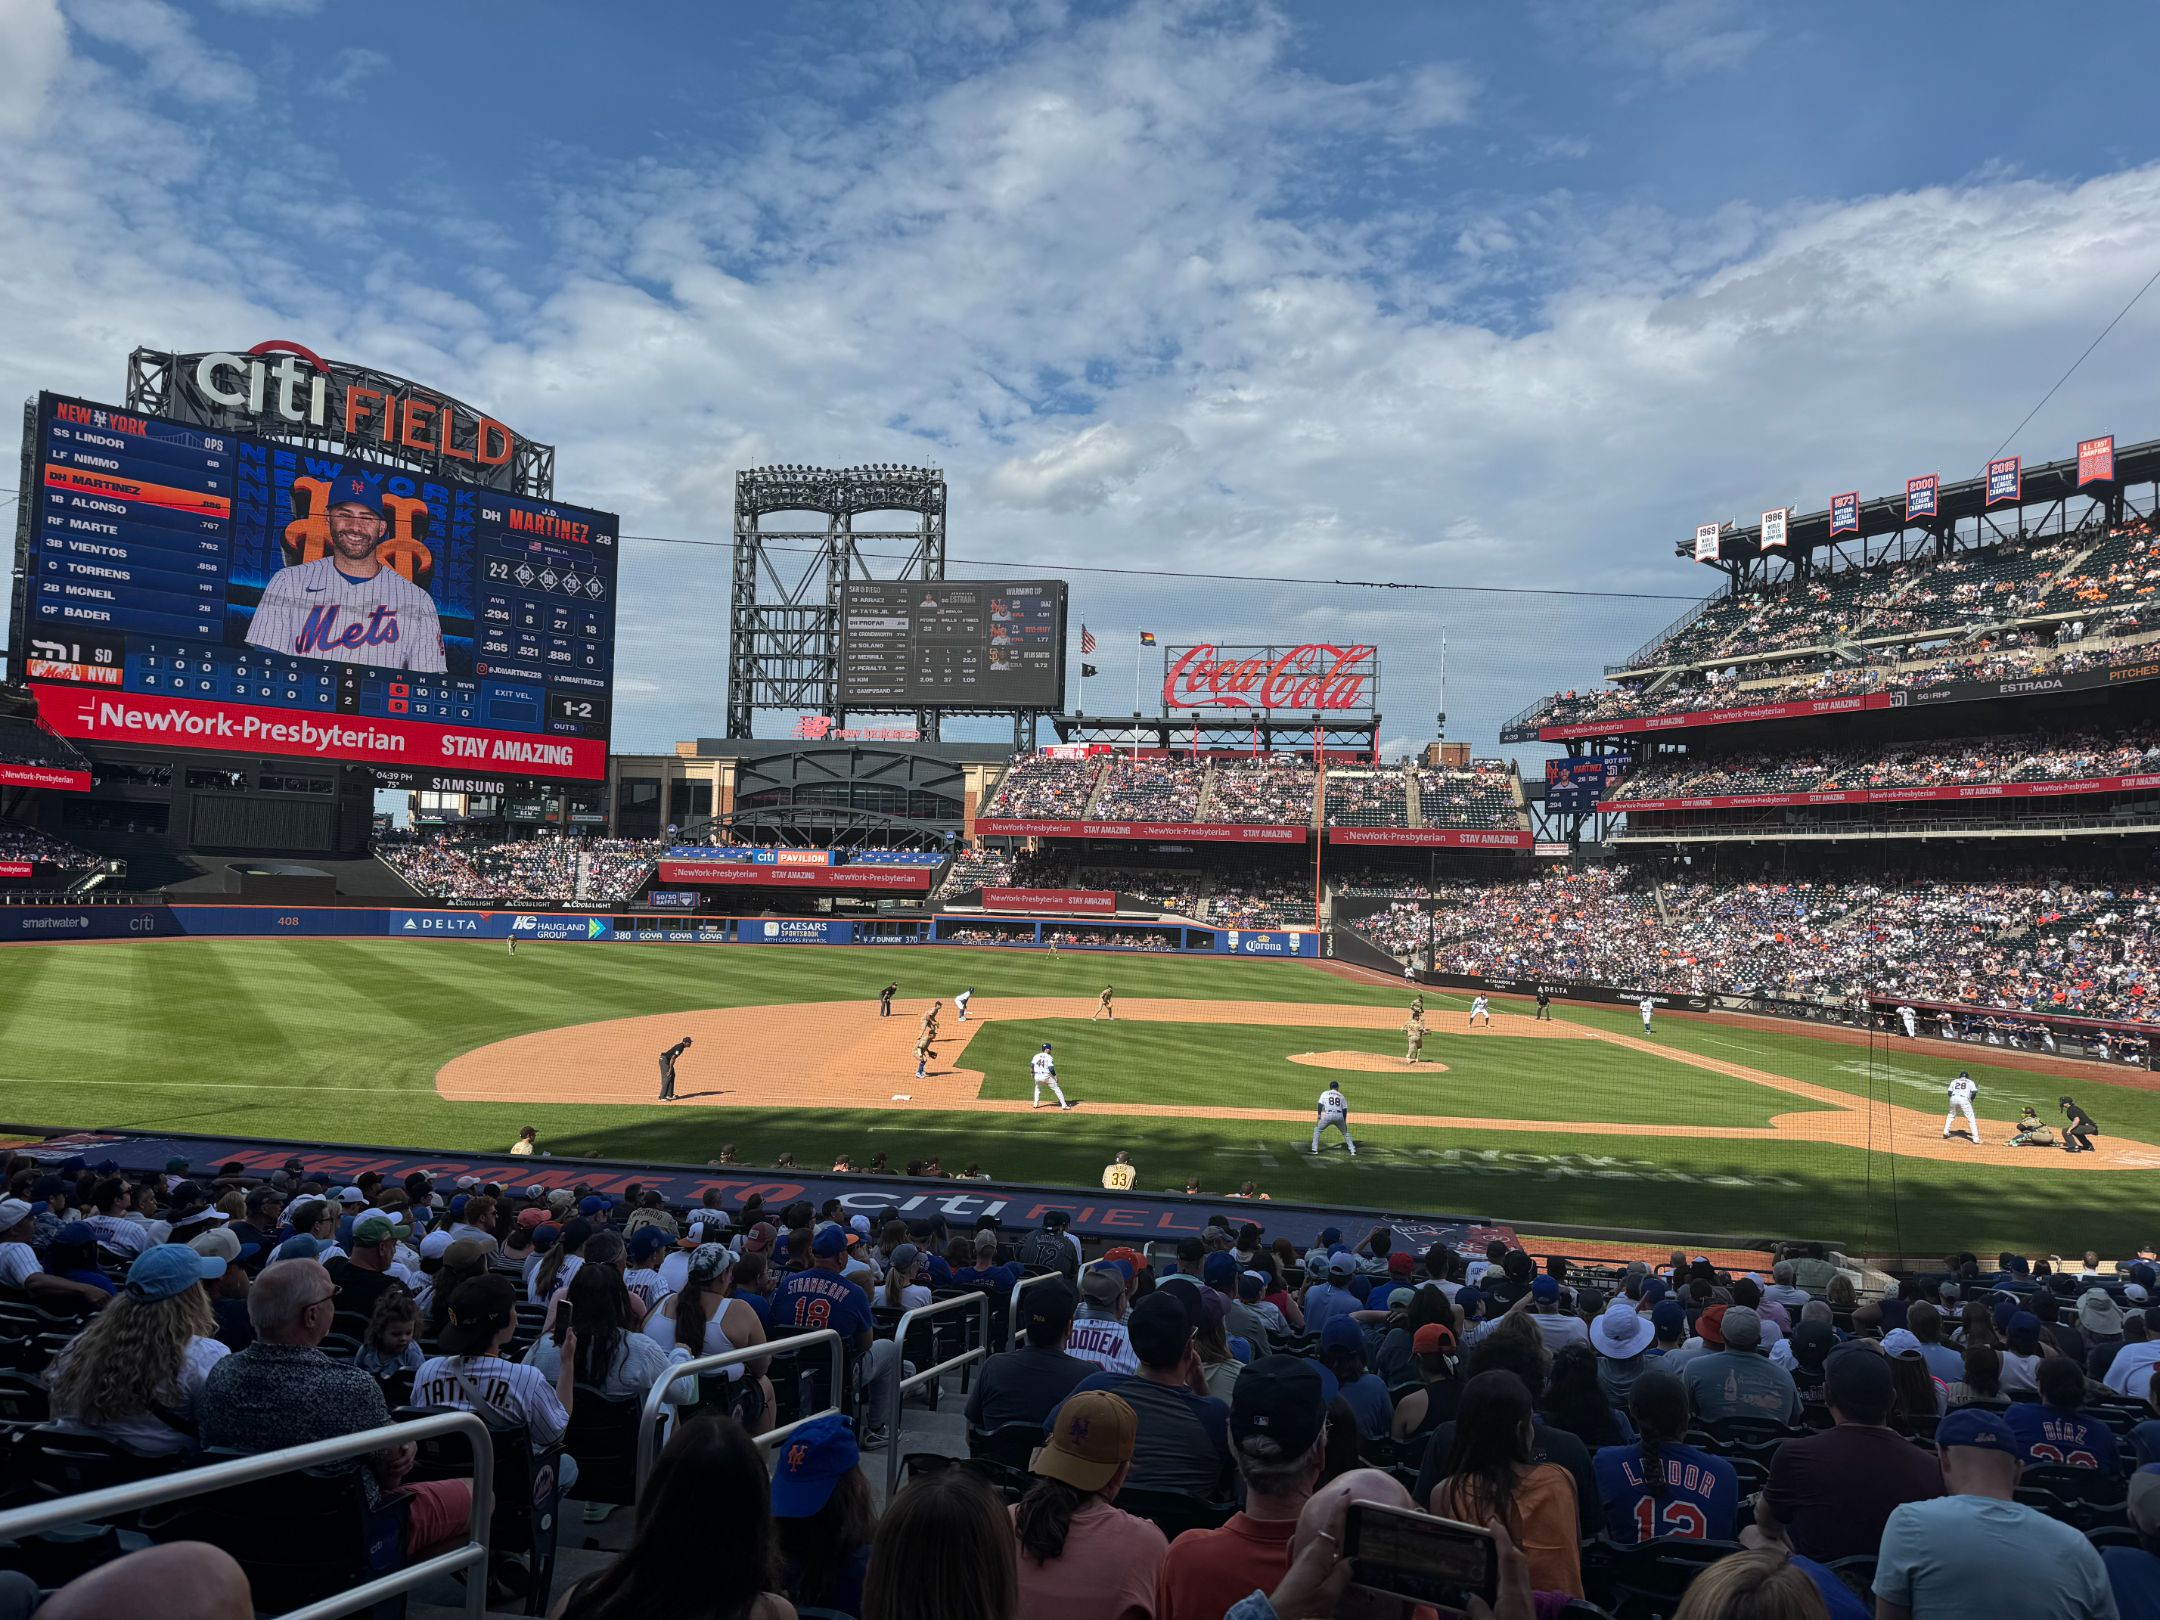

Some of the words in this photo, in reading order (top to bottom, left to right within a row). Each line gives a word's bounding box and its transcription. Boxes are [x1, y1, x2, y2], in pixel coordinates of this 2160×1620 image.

[56, 401, 92, 425] NEW
[109, 414, 148, 437] YORK
[345, 384, 513, 466] FIELD
[53, 427, 70, 438] SS
[75, 430, 125, 450] LINDOR
[206, 459, 220, 468] BB
[204, 436, 224, 452] OPS
[52, 449, 68, 460] LF
[73, 452, 120, 470] NIMMO
[207, 480, 218, 489] 1B
[1991, 460, 2016, 474] 2015
[49, 471, 67, 482] DH
[72, 474, 140, 496] MARTINEZ
[1909, 477, 1934, 492] 2000
[50, 494, 64, 504] 1B
[71, 497, 127, 515] ALONSO
[199, 521, 220, 531] .767
[482, 508, 501, 522] DH
[541, 508, 560, 518] J.D.
[1765, 511, 1783, 523] 1986
[47, 516, 65, 526] RF
[69, 518, 118, 535] MARTE
[198, 541, 219, 551] .762
[509, 508, 589, 545] MARTINEZ
[1699, 526, 1716, 537] 1969
[595, 533, 612, 546] 28
[46, 538, 63, 549] 3B
[68, 540, 128, 559] VIENTOS
[197, 563, 218, 572] .858
[48, 561, 58, 570] C
[67, 562, 131, 580] TORRENS
[199, 584, 213, 592] HR
[489, 562, 508, 579] 2-2
[43, 582, 60, 593] 2B
[65, 585, 116, 601] MCNEIL
[198, 604, 211, 612] 2B
[490, 597, 505, 605] AVG
[41, 605, 59, 615] CF
[64, 607, 111, 622] BADER
[198, 625, 209, 633] 1B
[484, 609, 510, 621] .294
[525, 615, 533, 624] 8
[295, 605, 400, 655] Mets
[553, 620, 568, 629] 27
[585, 624, 597, 634] 18
[482, 641, 508, 653] .365
[517, 646, 539, 657] .521
[547, 650, 571, 662] .886
[94, 648, 113, 664] SD
[416, 688, 428, 697] 10
[488, 666, 542, 680] @JDMARTINEZ28
[1164, 643, 1377, 709] Coca-Cola
[2109, 664, 2159, 681] PITCHES
[87, 664, 118, 683] NYM
[415, 705, 427, 713] 13
[457, 682, 475, 690] MVR
[554, 675, 605, 688] @JDMARTINEZ28
[1999, 678, 2063, 693] ESTRADA
[495, 689, 513, 698] EXIT
[515, 691, 533, 700] VEL.
[563, 700, 593, 718] 1-2
[1713, 707, 1786, 721] NewYork-Presbyterian
[1813, 702, 1829, 711] STAY
[1829, 699, 1860, 709] AMAZING
[100, 701, 405, 752] NewYork-Presbyterian
[441, 734, 491, 760] STAY
[491, 740, 573, 766] AMAZING
[832, 728, 862, 739] new
[863, 727, 920, 740] balance
[5, 770, 74, 784] NewYork-Presbyterian
[376, 771, 399, 781] 04:39
[400, 773, 413, 781] PM
[432, 777, 505, 794] SAMSUNG
[1870, 789, 1936, 799] NewYork-Presbyterian
[1960, 788, 1974, 796] STAY
[1975, 786, 2002, 795] AMAZING
[2033, 782, 2100, 793] NewYork-Presbyterian
[992, 822, 1071, 833] NewYork-Presbyterian
[1083, 826, 1100, 834] STAY
[1101, 826, 1131, 835] AMAZING
[1148, 826, 1230, 838] NewYork-Presbyterian
[1243, 829, 1260, 838] STAY
[1260, 829, 1293, 839] AMAZING
[1349, 831, 1446, 843] NewYork-Presbyterian
[1459, 833, 1479, 844] STAY
[1481, 834, 1519, 845] AMAZING
[757, 850, 775, 862] citi
[780, 853, 825, 864] PAVILION
[677, 868, 758, 879] NewYork-Presbyterian
[771, 871, 787, 879] STAY
[788, 871, 815, 880] AMAZING
[834, 873, 916, 884] NewYork-Presbyterian
[656, 892, 677, 900] 50/50
[990, 893, 1063, 904] NewYork-Presbyterian
[1068, 897, 1083, 905] STAY
[1083, 897, 1112, 906] AMAZING
[22, 917, 80, 929] smartwater
[130, 914, 154, 931] citi
[277, 916, 299, 926] 408
[422, 918, 477, 930] DELTA
[512, 915, 537, 931] HG
[537, 922, 586, 931] HAUGLAND
[781, 922, 827, 931] CAESARS
[537, 931, 567, 939] GROUP
[614, 931, 631, 940] 380
[640, 932, 662, 941] GOYA
[669, 932, 692, 941] GOYA
[699, 932, 722, 941] GOYA
[877, 935, 902, 943] DUNKIN'
[905, 935, 918, 944] 370
[1245, 939, 1282, 951] Corona
[1545, 986, 1568, 995] DELTA
[1954, 1082, 1967, 1090] 28
[1328, 1096, 1341, 1106] 88
[1111, 1172, 1127, 1186] 33
[686, 1178, 806, 1203] TO
[787, 1277, 850, 1303] STRAWBERRY
[794, 1298, 831, 1330] 18
[1064, 1329, 1123, 1359] OODEN
[2042, 1417, 2088, 1446] DÍAZ
[1621, 1457, 1716, 1499] LDOR
[1633, 1494, 1707, 1544] 12
